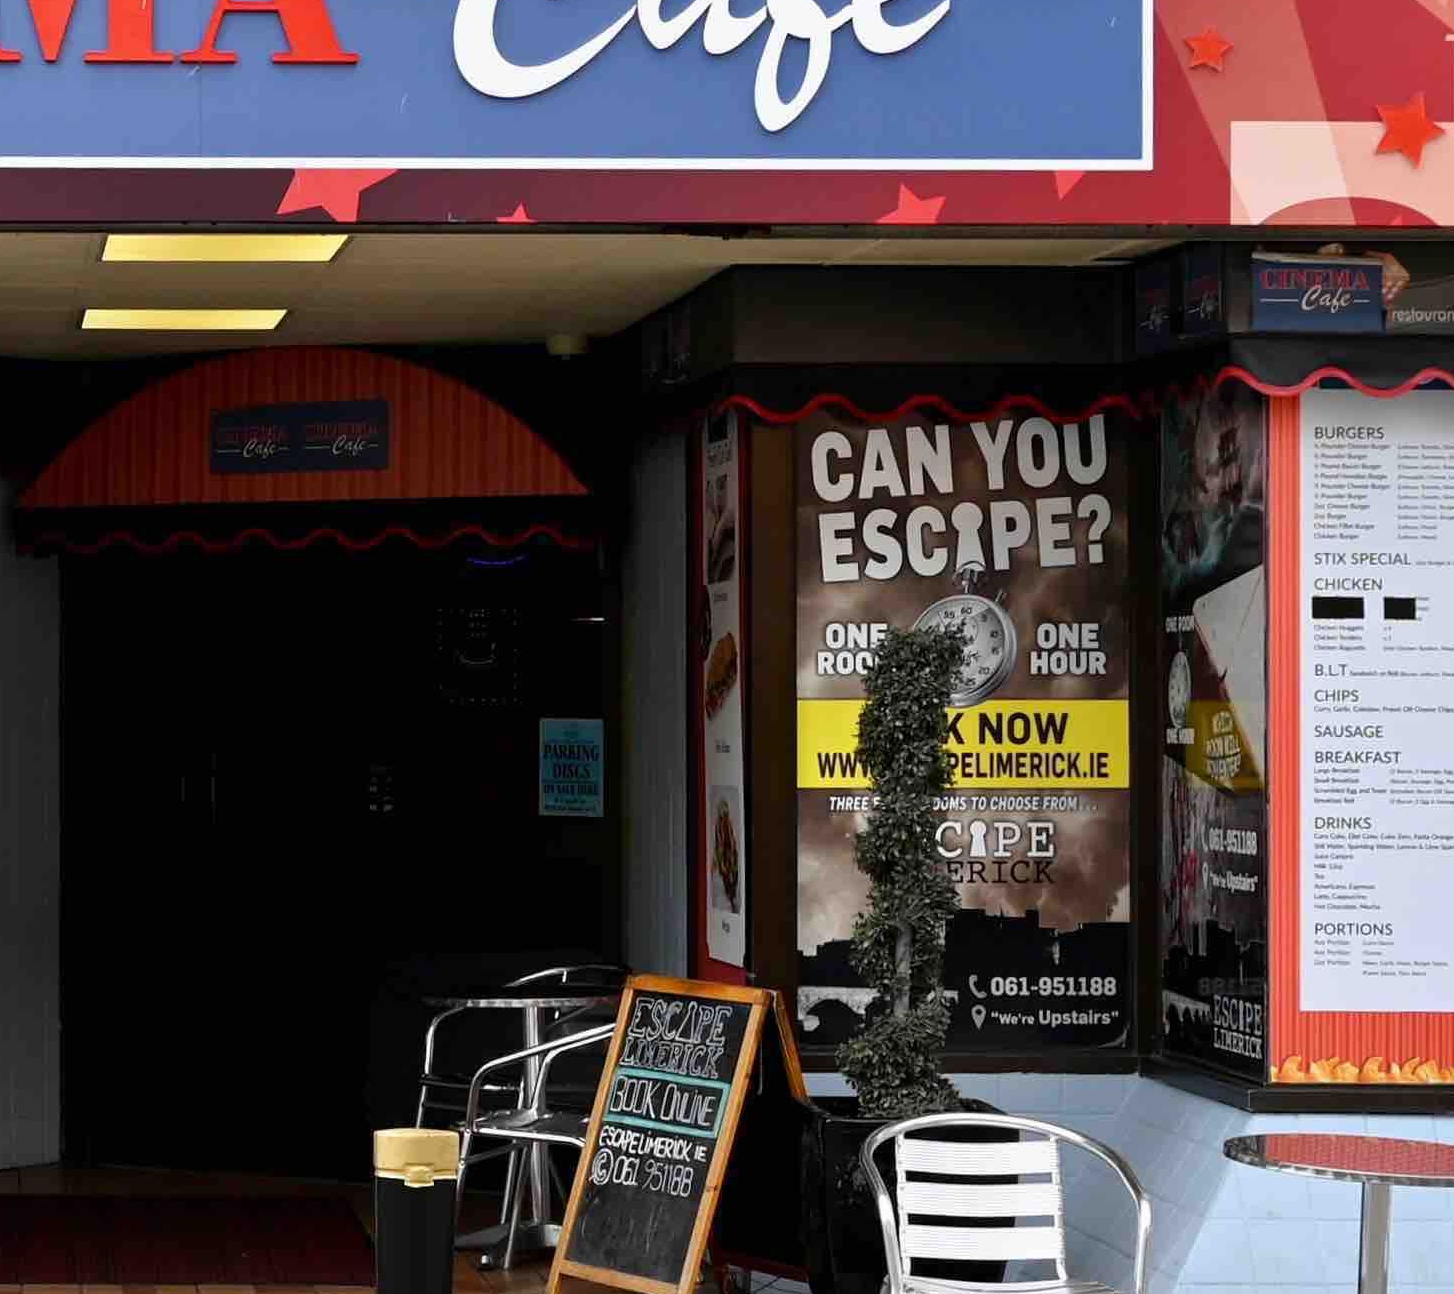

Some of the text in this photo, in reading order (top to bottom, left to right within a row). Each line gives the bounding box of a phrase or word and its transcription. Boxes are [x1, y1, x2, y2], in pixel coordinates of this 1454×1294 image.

[1261, 269, 1370, 290] CINEMA
[1314, 426, 1385, 440] BURGERS
[811, 414, 1108, 502] CAN YOU
[1314, 552, 1346, 565] STIX
[1351, 552, 1411, 565] SPECIAL
[1314, 578, 1383, 591] CHICKEN
[1037, 623, 1099, 649] ONE
[817, 651, 880, 674] ROO
[1030, 652, 1107, 675] HOUR
[1314, 689, 1359, 702] CHIPS
[978, 712, 1069, 745] NOW
[1314, 725, 1384, 738] SAUSAGE
[1314, 751, 1401, 764] BREAKFAST
[830, 796, 870, 811] THREE
[971, 796, 987, 811] TO
[990, 796, 1041, 811] CHOOSE
[1314, 816, 1372, 829] DRINKS
[1209, 828, 1258, 855] 061-951188
[1314, 922, 1394, 936] PORTIONS
[990, 976, 1117, 996] 061-951188
[627, 997, 732, 1046] ESCAPE
[1213, 1027, 1263, 1059] LIMERICK
[619, 1036, 724, 1079] LIMERICK
[610, 1076, 661, 1119] BOOK
[612, 1155, 694, 1197] 061 951188
